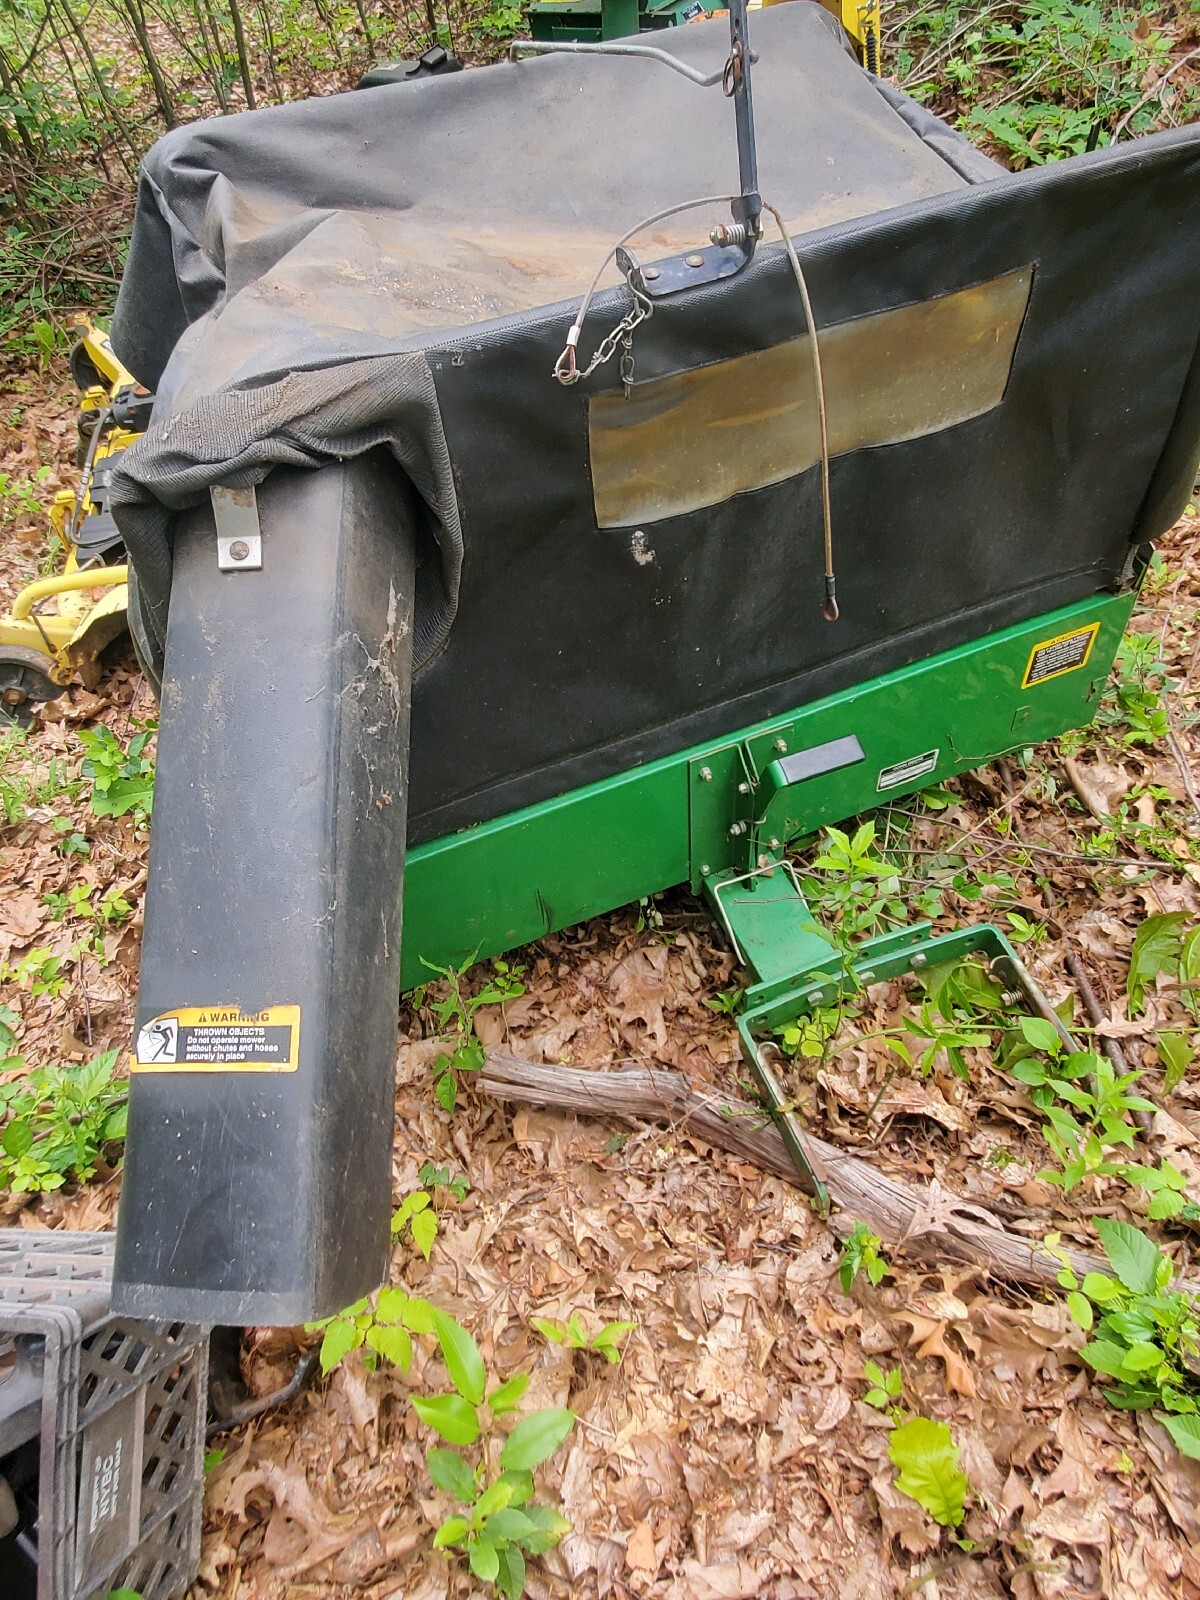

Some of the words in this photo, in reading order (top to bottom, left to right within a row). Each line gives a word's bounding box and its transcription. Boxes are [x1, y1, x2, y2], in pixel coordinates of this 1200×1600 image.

[193, 1028, 228, 1036] THROWN
[228, 1028, 265, 1036] OBJECTS
[187, 1036, 197, 1044] Do
[210, 1037, 239, 1045] operate
[238, 1044, 253, 1052] and
[254, 1044, 279, 1052] hoses
[185, 1053, 216, 1062] securely
[225, 1053, 246, 1062] place
[100, 1454, 114, 1520] NYBC
